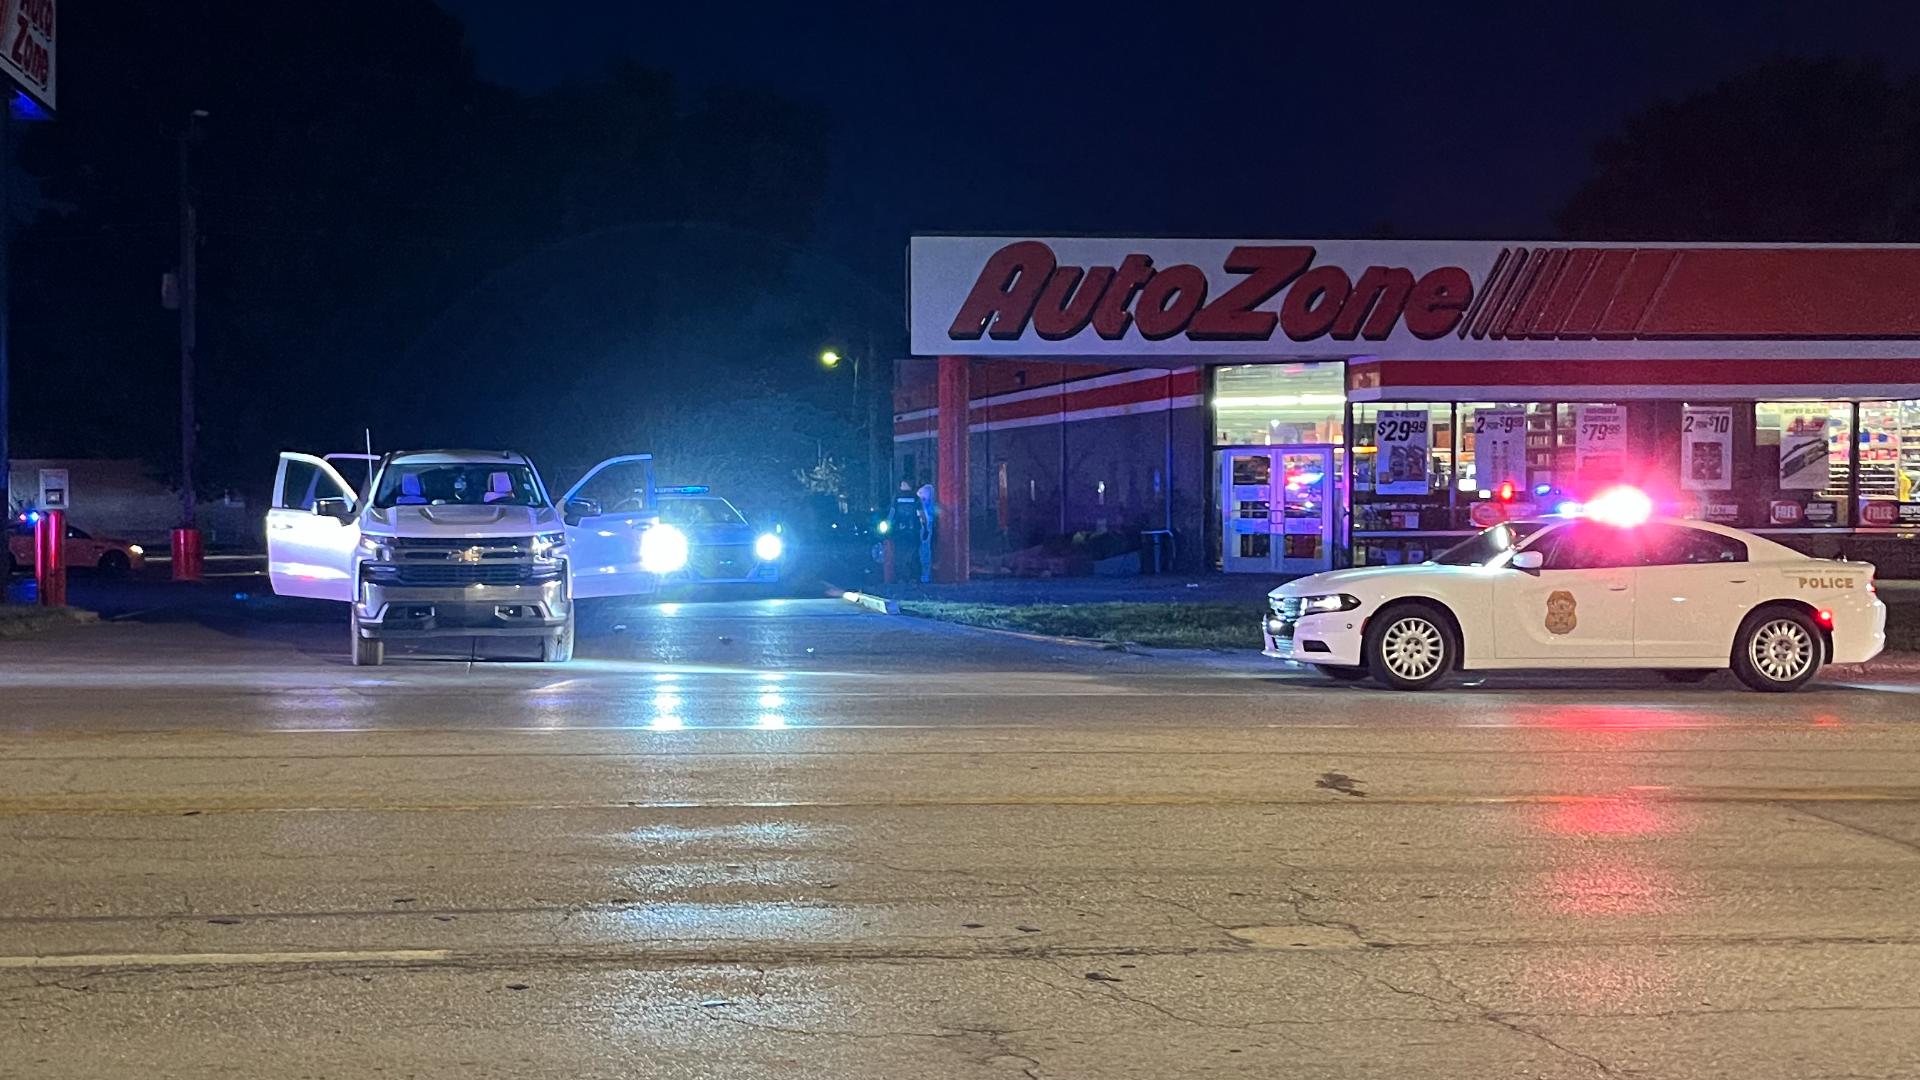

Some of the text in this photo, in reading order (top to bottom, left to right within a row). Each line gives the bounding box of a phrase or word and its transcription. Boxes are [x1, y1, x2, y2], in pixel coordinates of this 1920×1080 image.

[11, 13, 49, 89] Zone
[948, 240, 1475, 341] AutoZone
[1476, 416, 1486, 434] 2
[1683, 416, 1695, 433] 2
[1708, 416, 1730, 433] $10
[1866, 506, 1894, 520] FREE
[1798, 577, 1854, 589] POLICE
